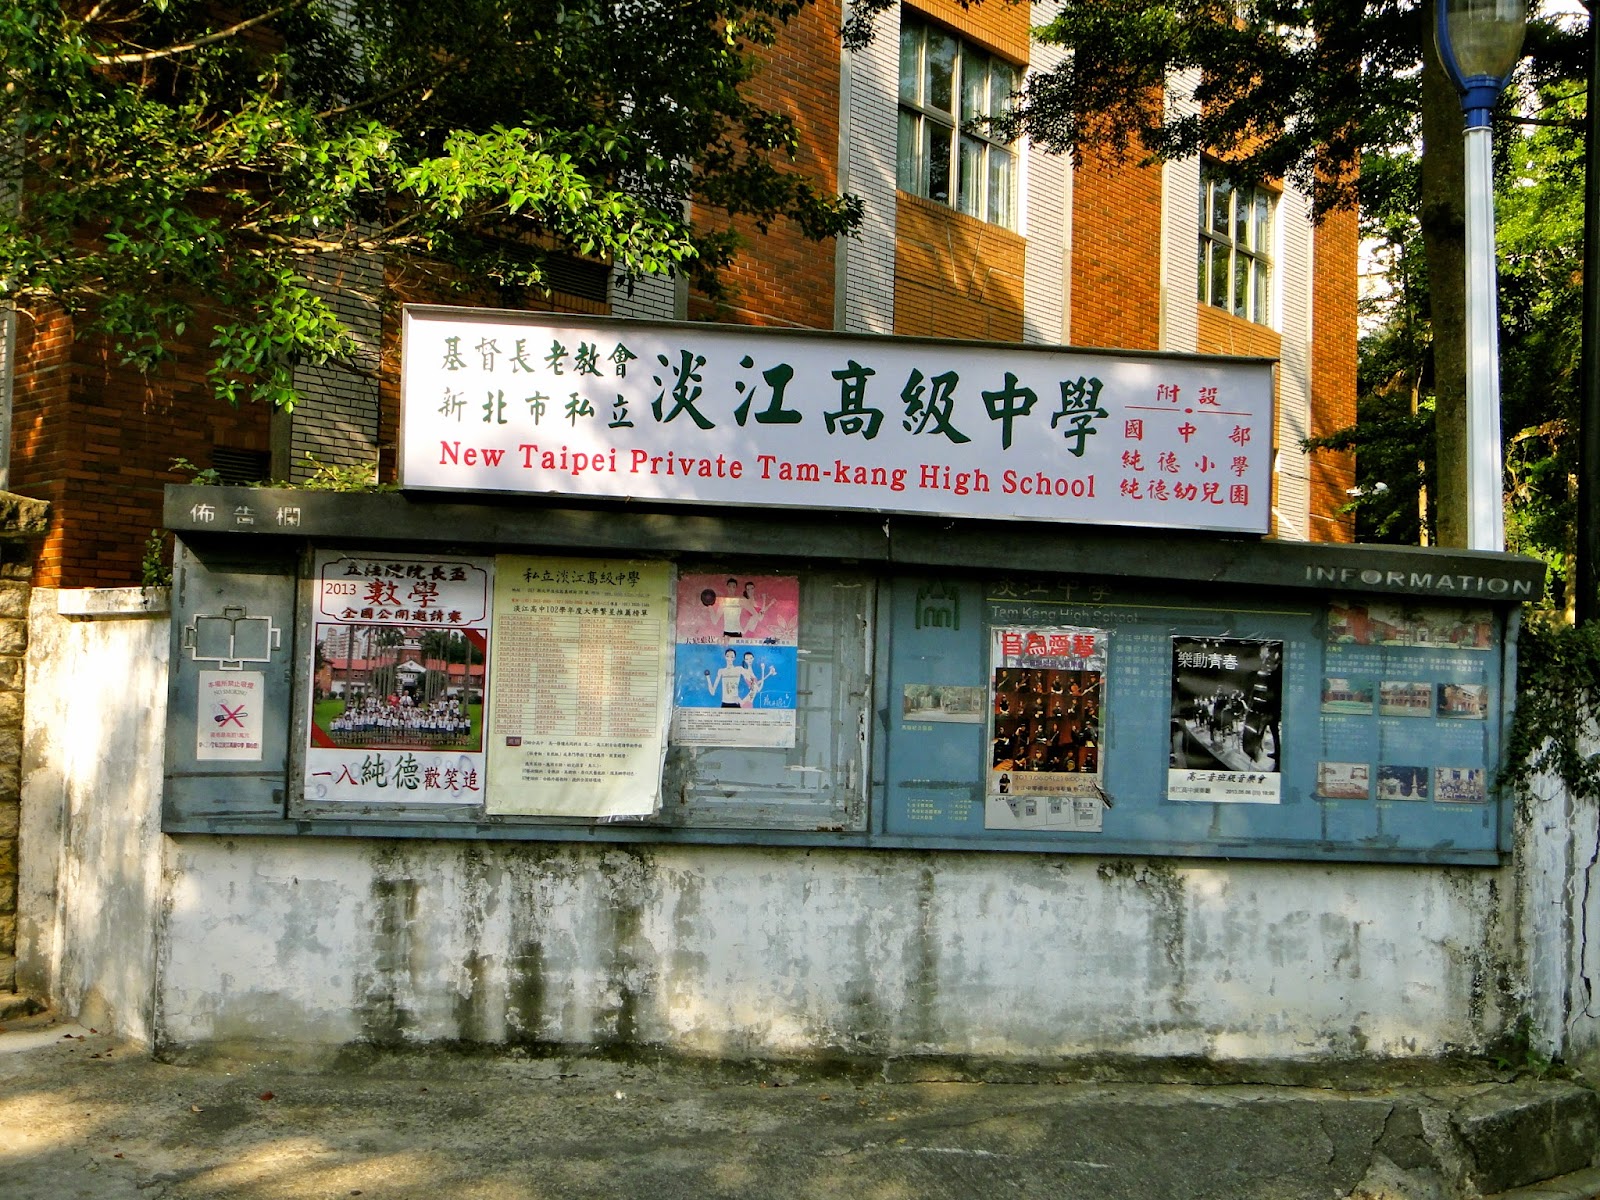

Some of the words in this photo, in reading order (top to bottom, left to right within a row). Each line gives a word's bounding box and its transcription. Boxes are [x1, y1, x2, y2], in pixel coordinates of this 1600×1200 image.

[441, 336, 638, 379] 基督長老教會
[438, 386, 634, 429] 新北市私立
[651, 348, 1109, 457] 淡江高級中學
[1156, 383, 1222, 406] 附設
[1124, 418, 1251, 447] 國中部
[439, 440, 506, 466] New
[519, 443, 616, 476] Taipei
[630, 449, 743, 479] Private
[757, 454, 907, 492] Tam-kang
[919, 464, 990, 495] High
[1002, 469, 1095, 498] School
[1121, 449, 1249, 477] 純德小學
[1119, 477, 1249, 506] 純德幼兒園
[190, 503, 301, 526] 佈告欄
[523, 568, 640, 587] 私立淡江高級中學
[1305, 564, 1533, 595] INFORMATION
[325, 583, 357, 595] 2013
[363, 578, 440, 609] 數學
[341, 607, 462, 624] 全國公開邀請賽
[991, 606, 1018, 618] Tam
[1022, 607, 1056, 622] Kang
[1177, 651, 1239, 671] 樂動青春
